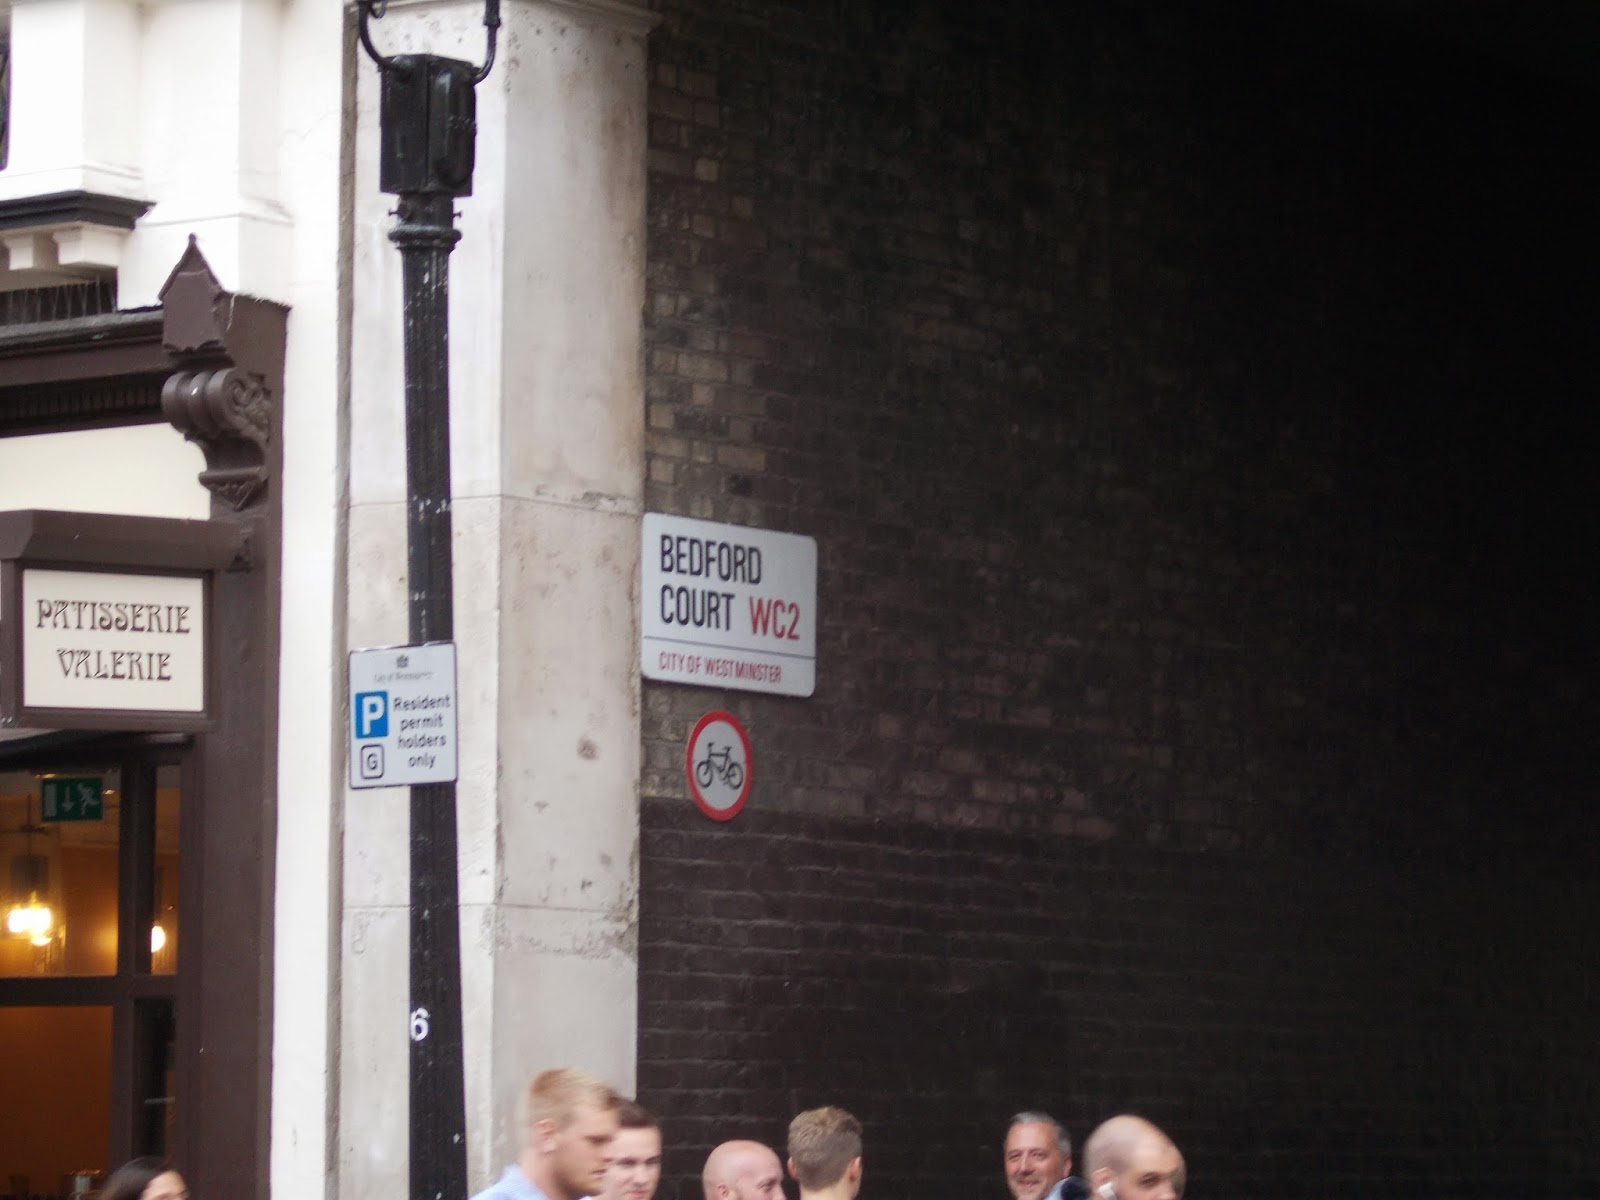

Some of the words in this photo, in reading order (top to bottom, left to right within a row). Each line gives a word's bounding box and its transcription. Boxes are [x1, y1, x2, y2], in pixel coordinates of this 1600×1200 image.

[660, 534, 763, 585] BEDFORD
[36, 599, 190, 634] PATISSERIE
[660, 584, 735, 632] COURT
[749, 596, 801, 641] WC2
[57, 648, 172, 681] VALERIE
[659, 651, 685, 671] CITY
[688, 655, 702, 674] OF
[705, 657, 782, 684] WESTMINSTER
[362, 695, 385, 736] P
[393, 694, 451, 712] Resident
[400, 713, 443, 732] permit
[397, 733, 447, 750] holders
[407, 752, 436, 769] only
[410, 1007, 429, 1041] 6
